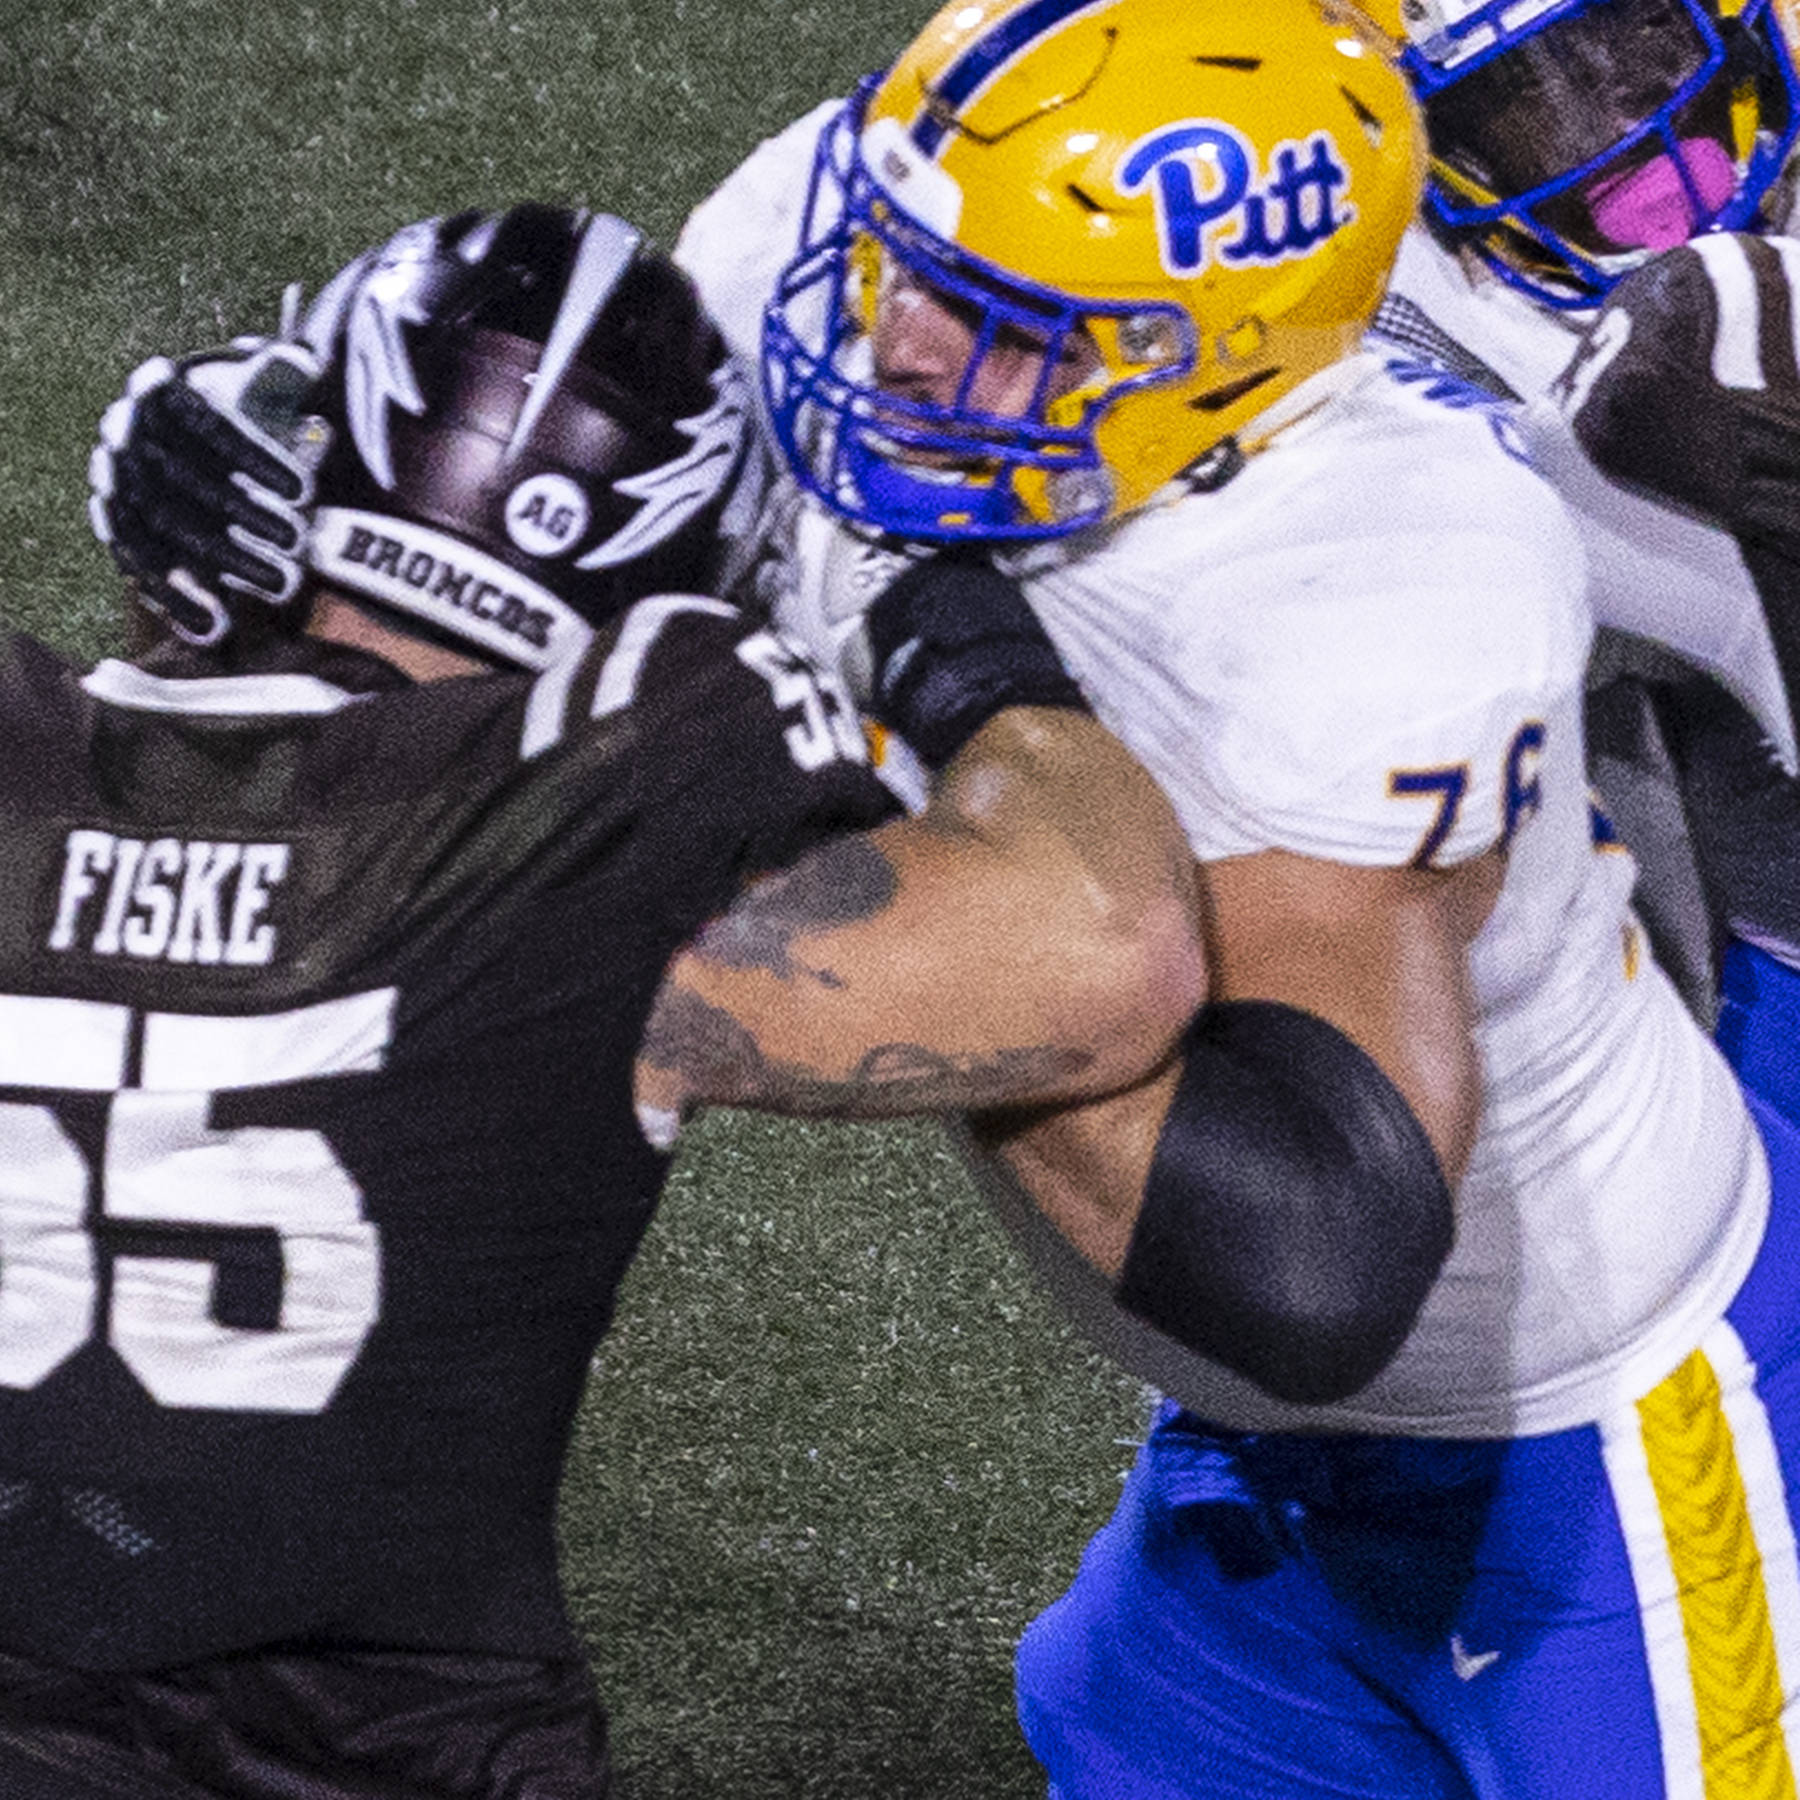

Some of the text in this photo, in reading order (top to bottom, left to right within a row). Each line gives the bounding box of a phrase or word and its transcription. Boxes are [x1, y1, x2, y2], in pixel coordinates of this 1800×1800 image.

[1113, 118, 1357, 279] Pitt
[340, 524, 556, 649] BRONCOS
[48, 828, 291, 965] FISKE
